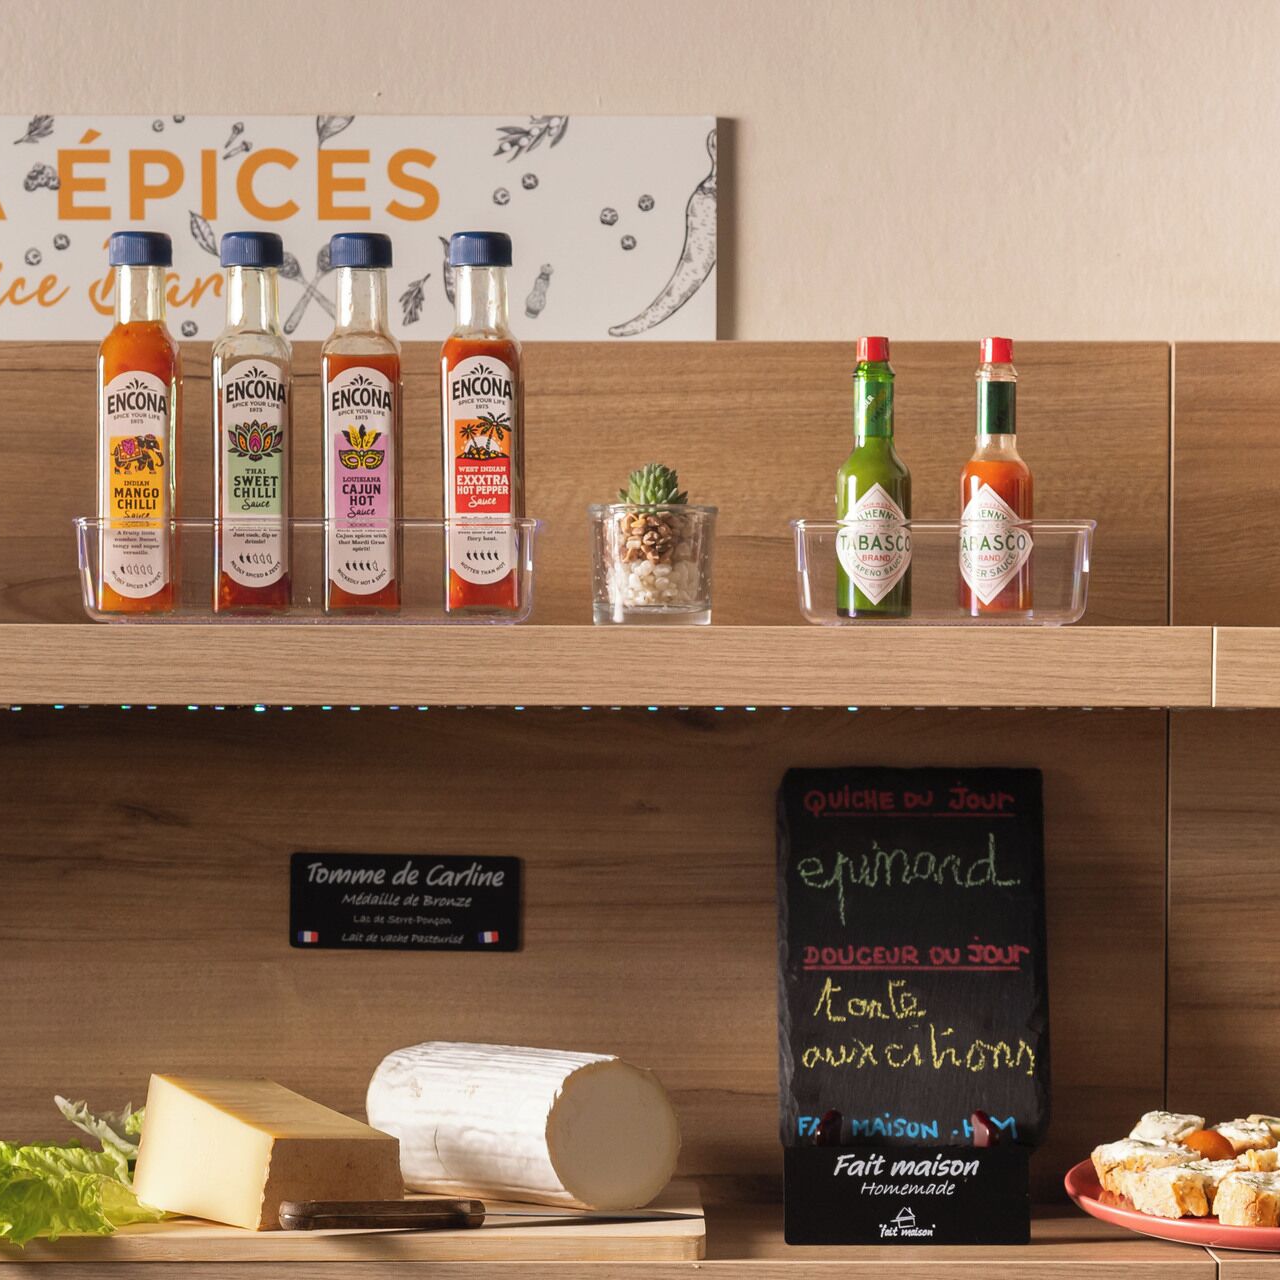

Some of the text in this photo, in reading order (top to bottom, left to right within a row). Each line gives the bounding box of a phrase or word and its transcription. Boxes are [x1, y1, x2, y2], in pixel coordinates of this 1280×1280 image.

[56, 127, 441, 223] ÉPICES
[226, 379, 287, 405] ENCONA
[452, 376, 513, 401] ENCONA
[107, 391, 168, 416] ENCONA
[332, 387, 393, 412] ENCONA
[245, 467, 266, 475] THAI
[233, 475, 279, 487] SWEET
[456, 474, 509, 486] EXXXTRA
[113, 487, 160, 498] MANGO
[233, 487, 276, 498] CHILLI
[342, 483, 381, 495] CAJUN
[456, 485, 509, 495] HOT PEPPER
[117, 499, 157, 510] CHILLI
[241, 498, 271, 511] Sauce
[349, 495, 375, 506] HOT
[468, 495, 497, 509] Sauce
[347, 506, 376, 519] Sauce
[840, 534, 911, 553] TABASCO
[862, 553, 891, 561] BRAND
[978, 553, 1001, 561] RAND
[989, 552, 1017, 577] SAUCE
[803, 785, 896, 817] QUICHE
[903, 789, 933, 809] DU
[307, 860, 505, 887] Tomme de Carline
[341, 892, 473, 908] Médaille de Bronze
[353, 914, 453, 927] Lac de Serre-Ponçon
[341, 932, 464, 945] Lait de vache Pasteurisé
[803, 944, 919, 965] DOUCEUR
[833, 1152, 980, 1177] Fait maison
[860, 1179, 957, 1196] Homemade
